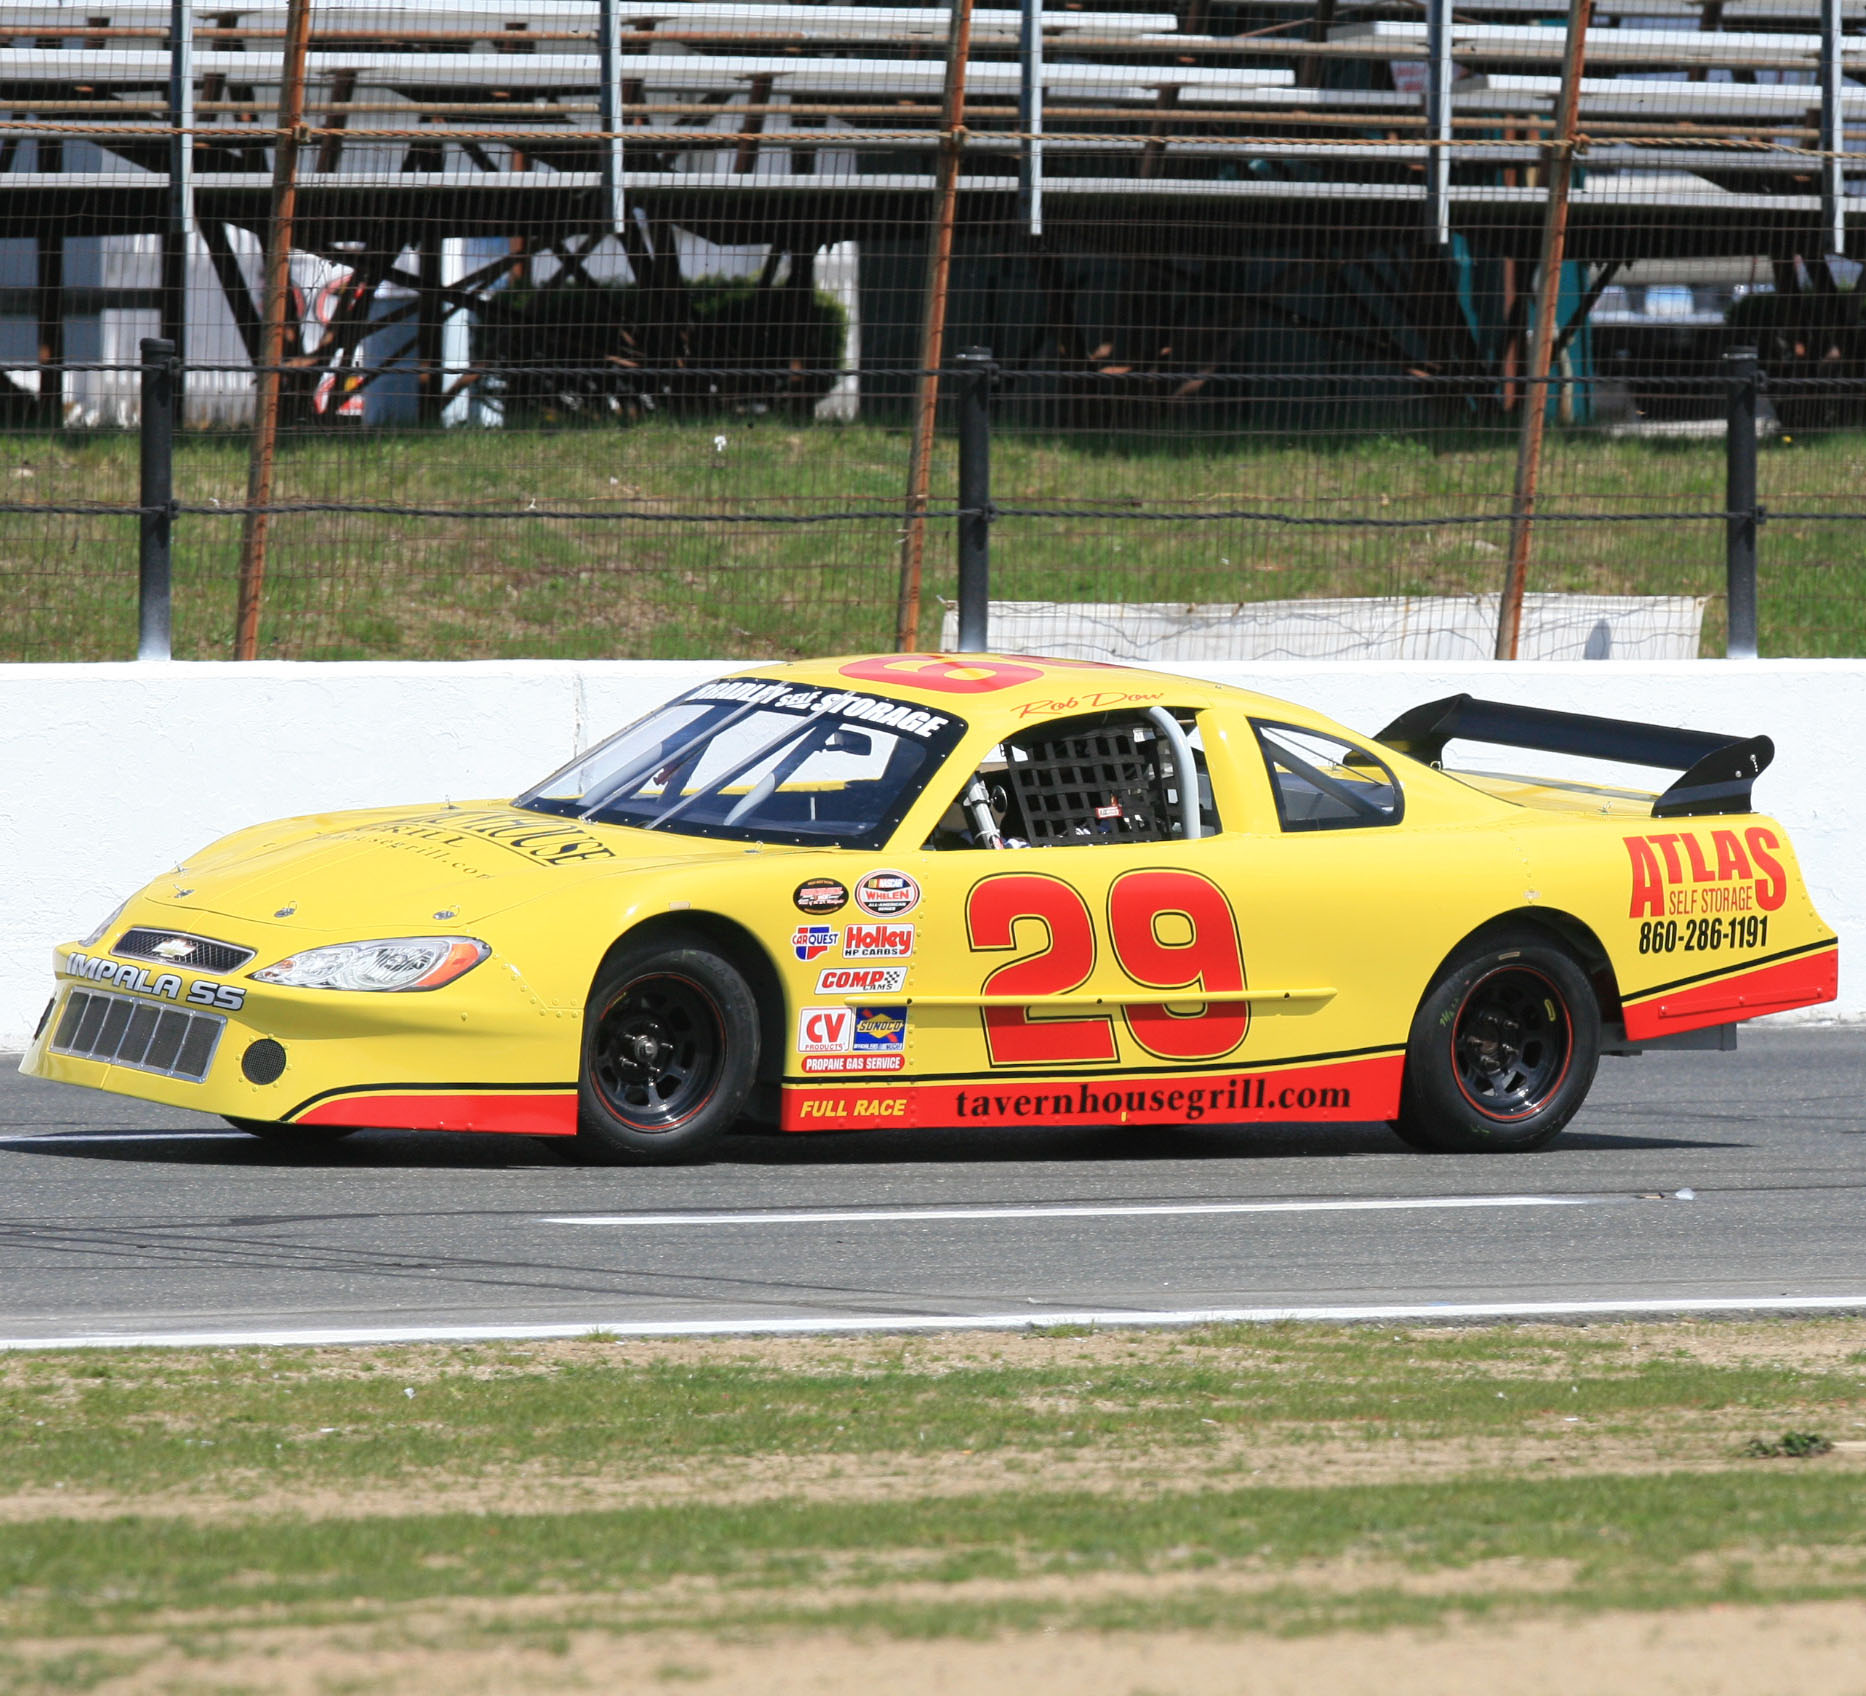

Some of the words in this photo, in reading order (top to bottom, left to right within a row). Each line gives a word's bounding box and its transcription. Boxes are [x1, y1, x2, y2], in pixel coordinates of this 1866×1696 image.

[775, 691, 822, 710] SELF
[810, 693, 949, 737] STORAGE
[1010, 697, 1079, 719] Rob
[1082, 692, 1164, 707] Dow
[1622, 826, 1787, 919] ATLAS
[865, 889, 909, 900] WHELEN
[1669, 889, 1698, 915] SELF
[1701, 886, 1753, 914] STORAGE
[792, 933, 839, 945] CARQUEST
[845, 926, 912, 955] Holley
[1639, 915, 1768, 954] 860-286-1191
[862, 948, 898, 956] CARBS
[65, 952, 183, 1000] IMPALA
[186, 979, 247, 1012] SS
[821, 970, 885, 989] COMP
[965, 867, 1251, 1069] 29
[863, 983, 893, 991] CAMS
[805, 1013, 846, 1044] CV
[860, 1021, 901, 1031] SUNOCO
[806, 1058, 844, 1071] PROPANE
[846, 1058, 864, 1070] GAS
[866, 1057, 901, 1070] SERVICE
[800, 1100, 848, 1118] FULL
[853, 1099, 907, 1116] RACE
[956, 1079, 1351, 1120] tavernhousegrill.com
